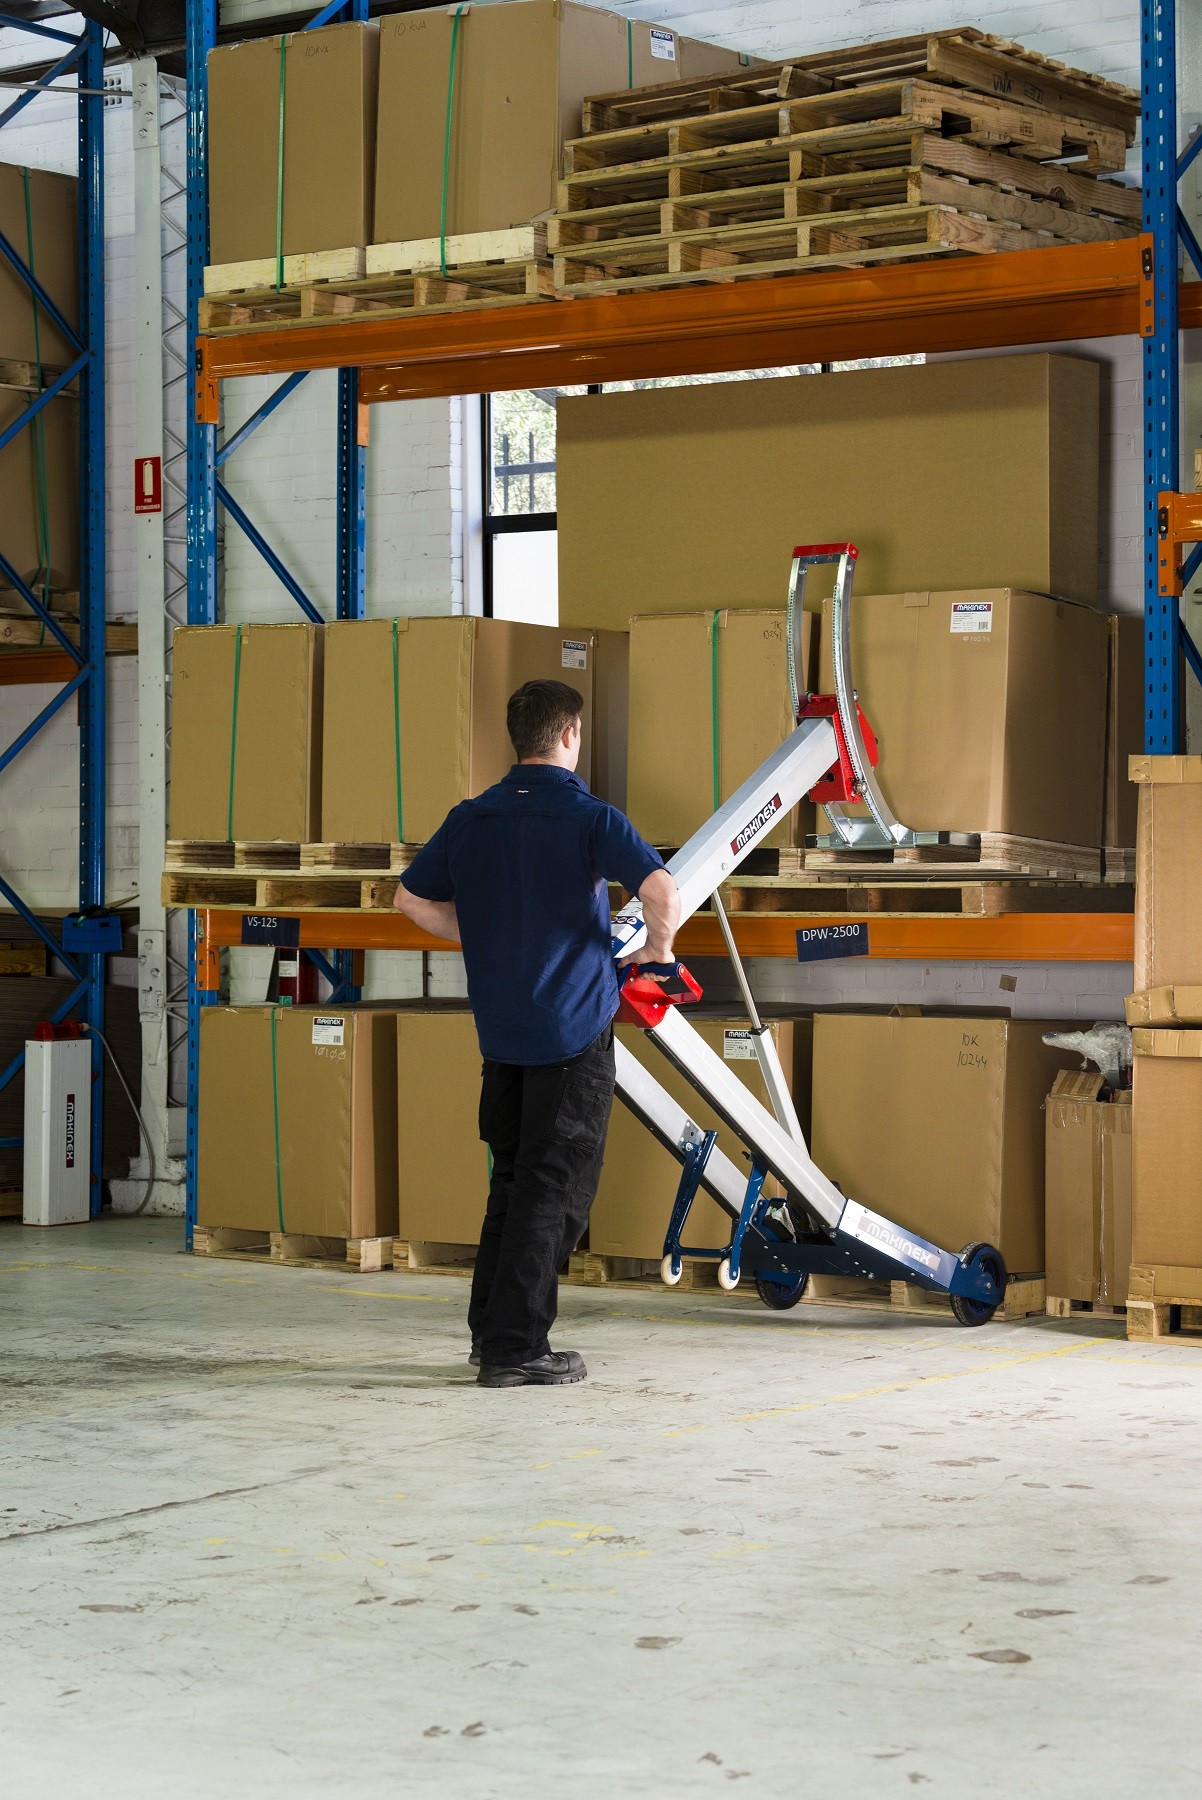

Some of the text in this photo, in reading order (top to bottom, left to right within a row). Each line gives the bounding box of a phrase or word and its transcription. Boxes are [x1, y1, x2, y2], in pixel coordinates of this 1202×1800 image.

[565, 641, 585, 650] MAKINEX
[736, 799, 777, 850] MAKINEX
[247, 916, 278, 928] VS-125
[802, 924, 860, 942] DPW-2500
[316, 1018, 341, 1026] MAKINEX
[957, 1050, 988, 1069] 10244
[67, 1102, 75, 1160] MAKINEX
[866, 1222, 933, 1266] MAKINEX
